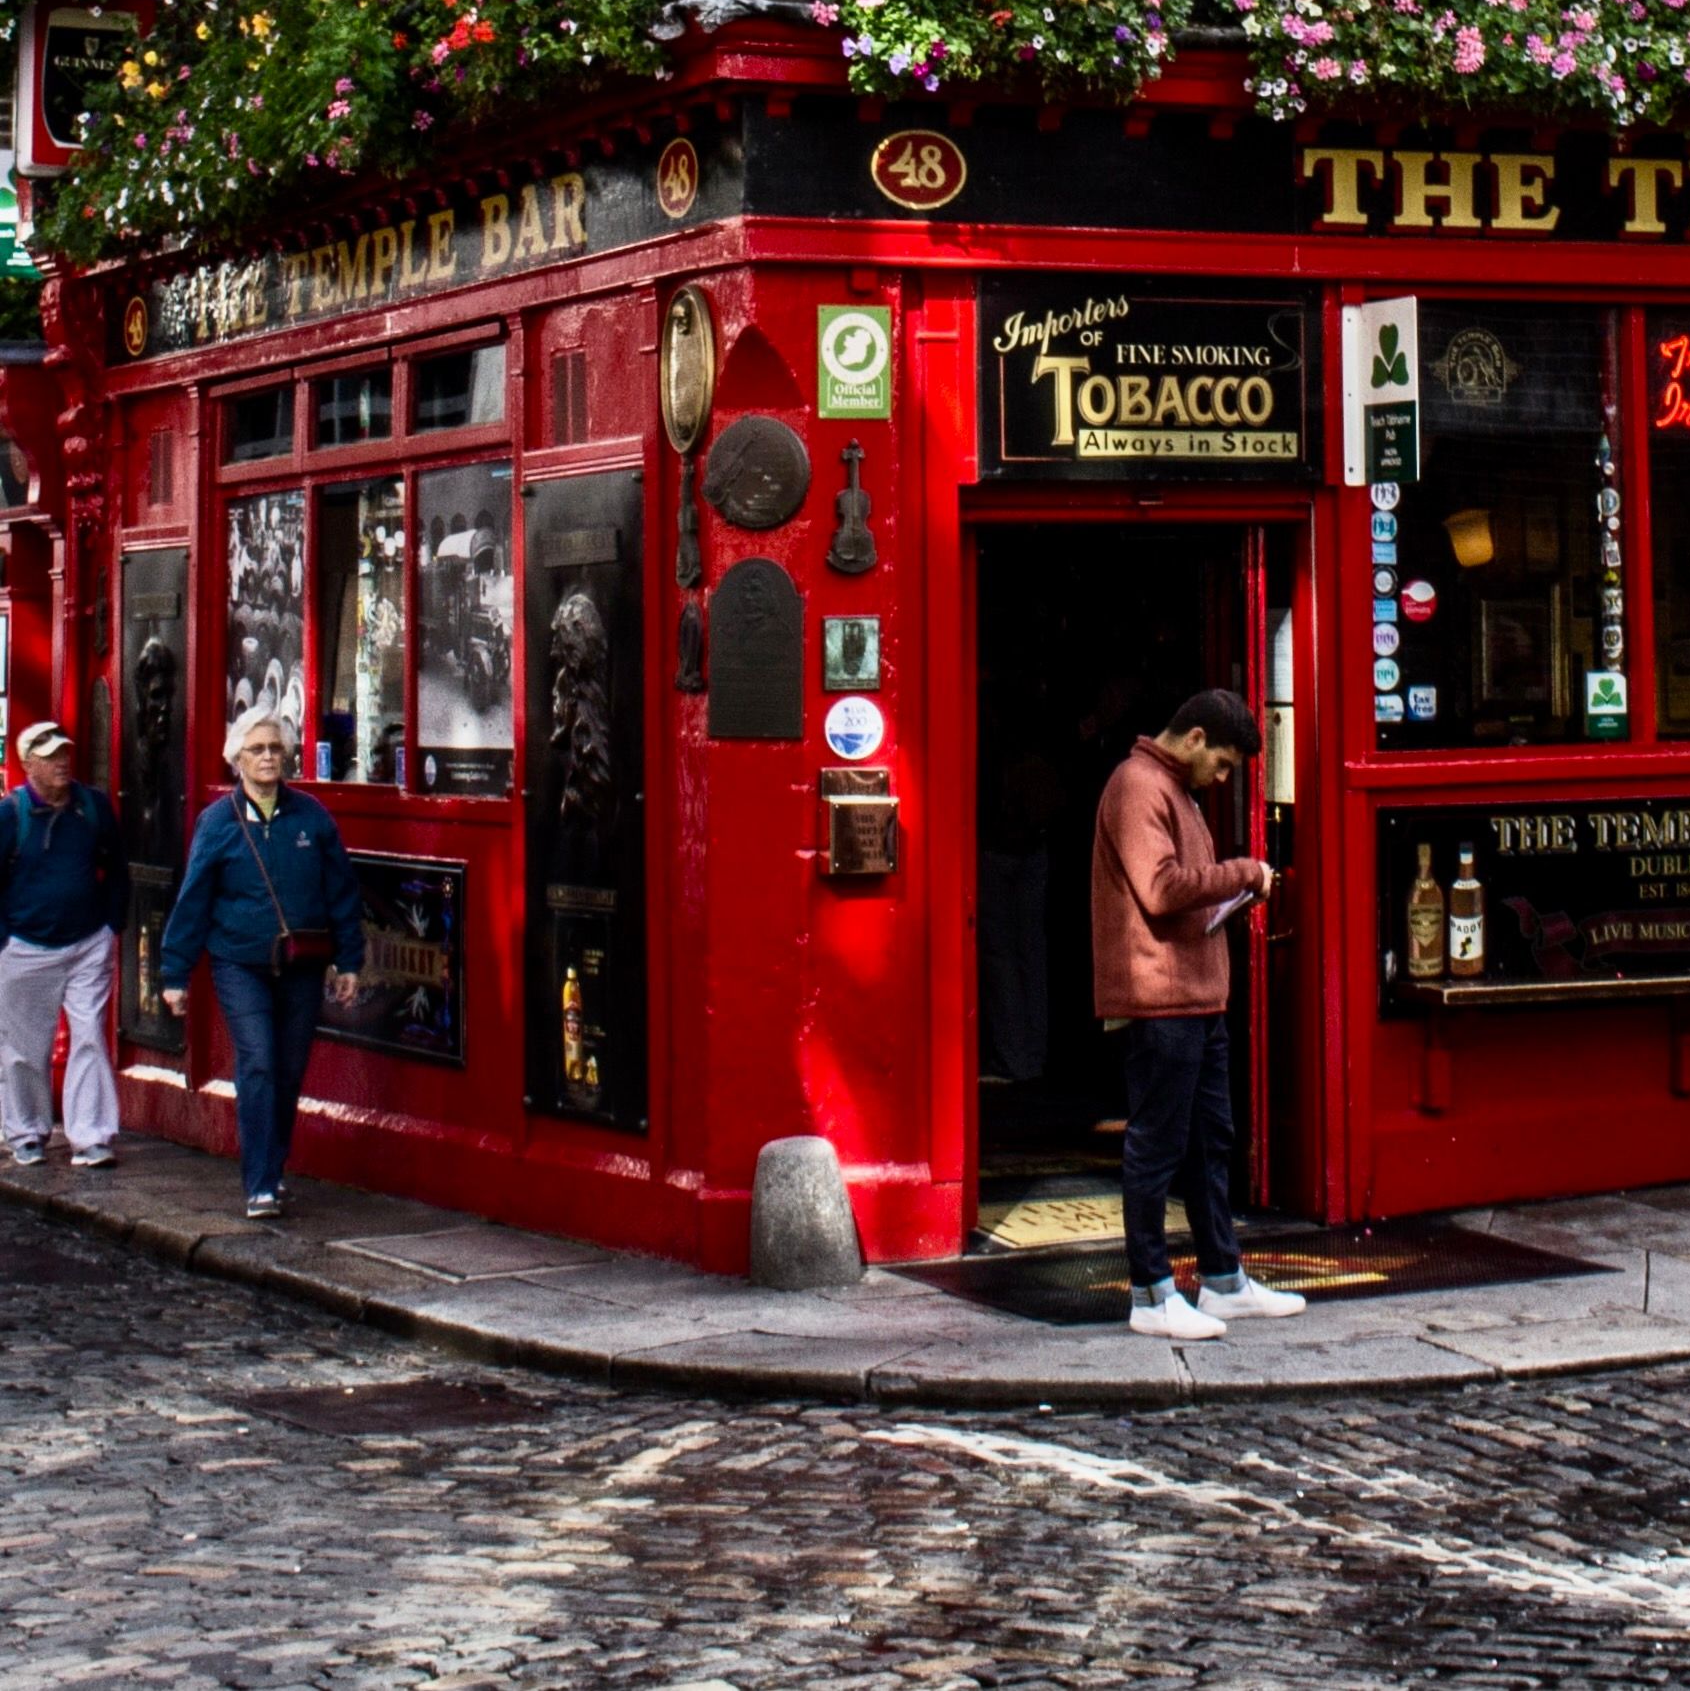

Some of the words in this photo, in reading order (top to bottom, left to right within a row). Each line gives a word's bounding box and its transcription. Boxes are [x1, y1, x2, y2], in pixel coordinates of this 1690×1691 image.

[54, 55, 116, 72] GUINNES
[889, 140, 945, 191] 48
[664, 153, 692, 203] 48
[1302, 148, 1560, 233] THE
[284, 209, 456, 316] TEMPLE
[481, 172, 589, 267] BAR
[127, 307, 146, 347] 48
[993, 294, 1129, 356] Importers
[1080, 330, 1104, 347] OF
[1116, 344, 1167, 366] FINE
[1171, 345, 1272, 367] SMOKING
[830, 396, 881, 408] Member
[834, 383, 876, 397] Official
[1031, 355, 1275, 447] TOBACCO
[1084, 430, 1175, 455] Always
[1188, 433, 1211, 454] in
[1221, 431, 1295, 455] Stock
[1413, 693, 1431, 705] tax
[1491, 814, 1578, 855] THE
[1638, 881, 1671, 900] EST.
[1450, 921, 1483, 935] PADDY
[1590, 923, 1635, 945] LIVE
